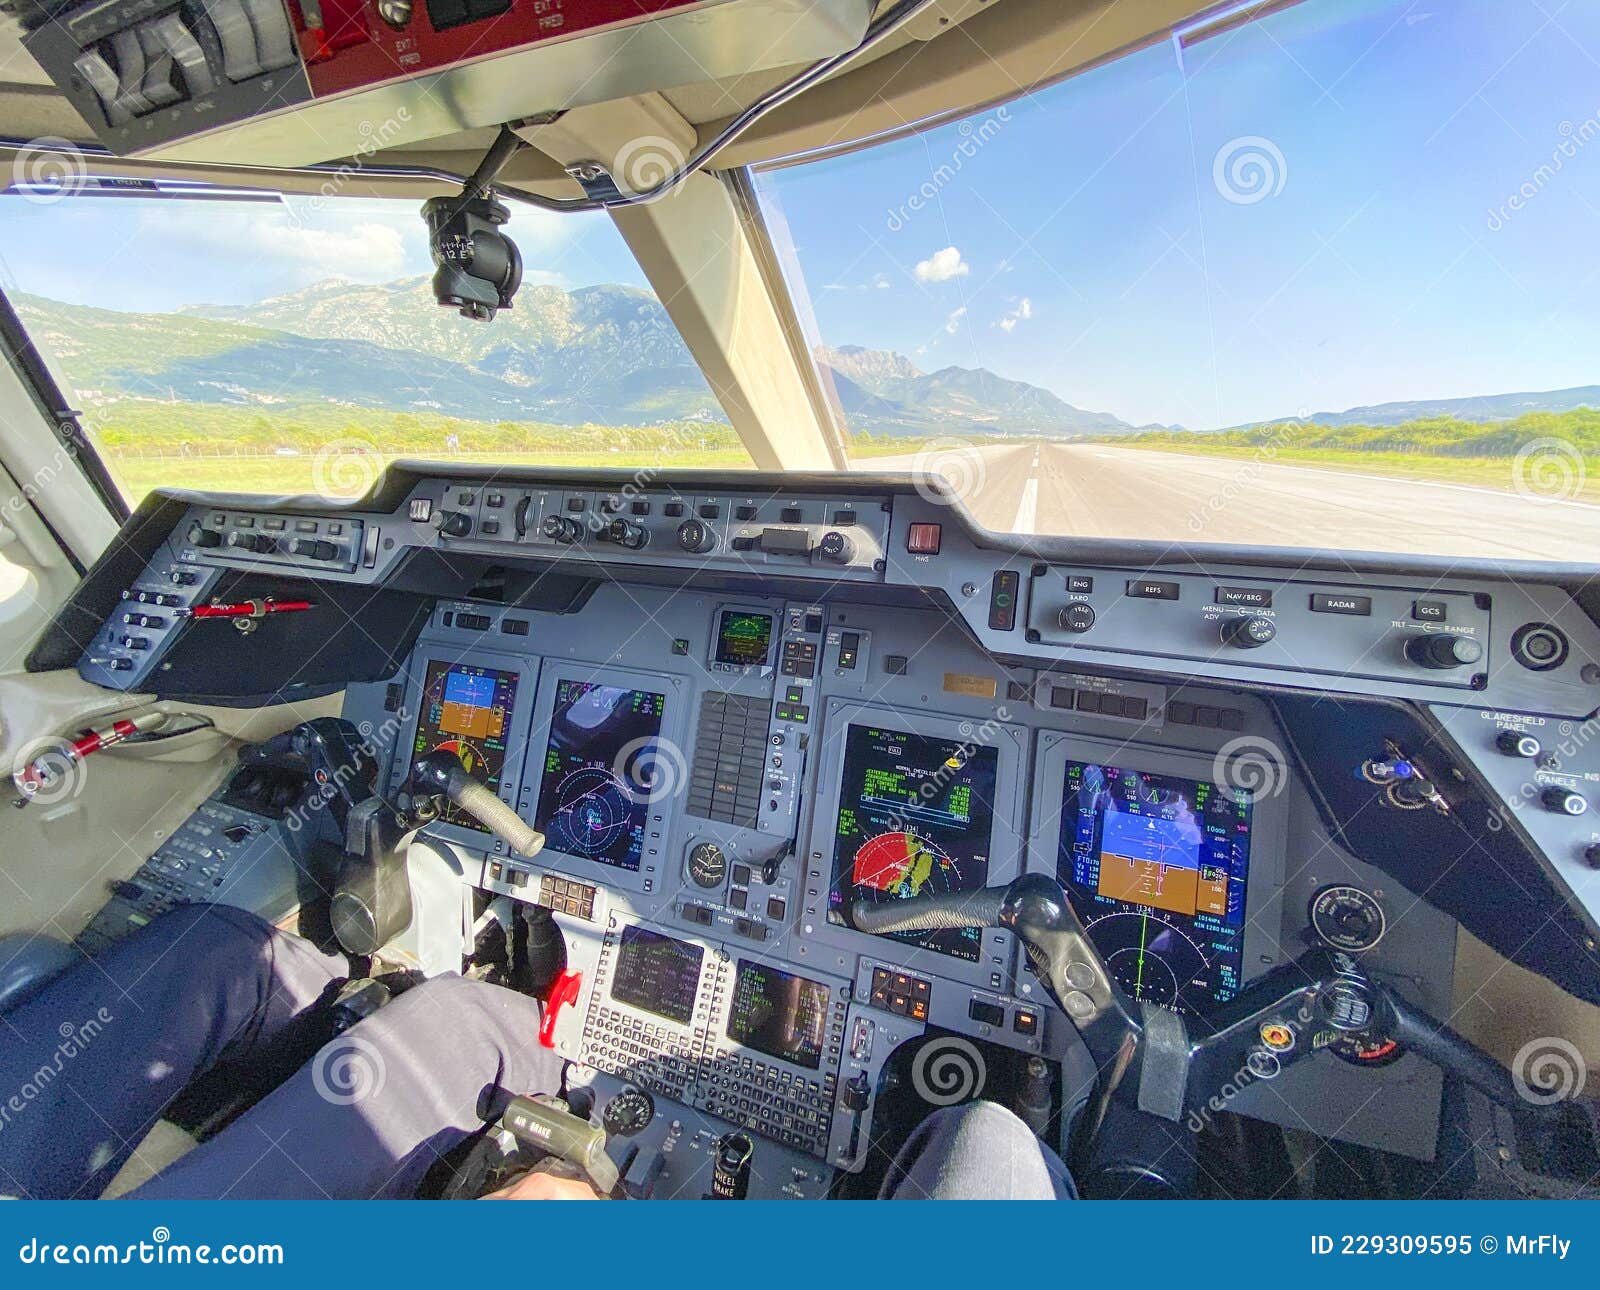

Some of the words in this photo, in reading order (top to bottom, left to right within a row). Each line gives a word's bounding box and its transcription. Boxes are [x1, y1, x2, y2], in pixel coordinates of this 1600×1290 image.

[1145, 586, 1162, 594] REFS
[1327, 600, 1356, 609] RADAR
[1202, 605, 1224, 613] MENU
[1256, 609, 1276, 617] DATA
[1421, 607, 1440, 615] GCS
[1444, 625, 1475, 635] RANGE
[1480, 711, 1546, 726] GLARESHIELD
[1496, 720, 1528, 732] PANEL
[889, 747, 901, 755] FULL
[1538, 774, 1577, 787] PANELS
[1207, 825, 1226, 834] 10000
[717, 916, 734, 926] POWER
[529, 1121, 552, 1139] BRAKE
[715, 1169, 736, 1187] WHEEL
[713, 1182, 734, 1197] BRAKE
